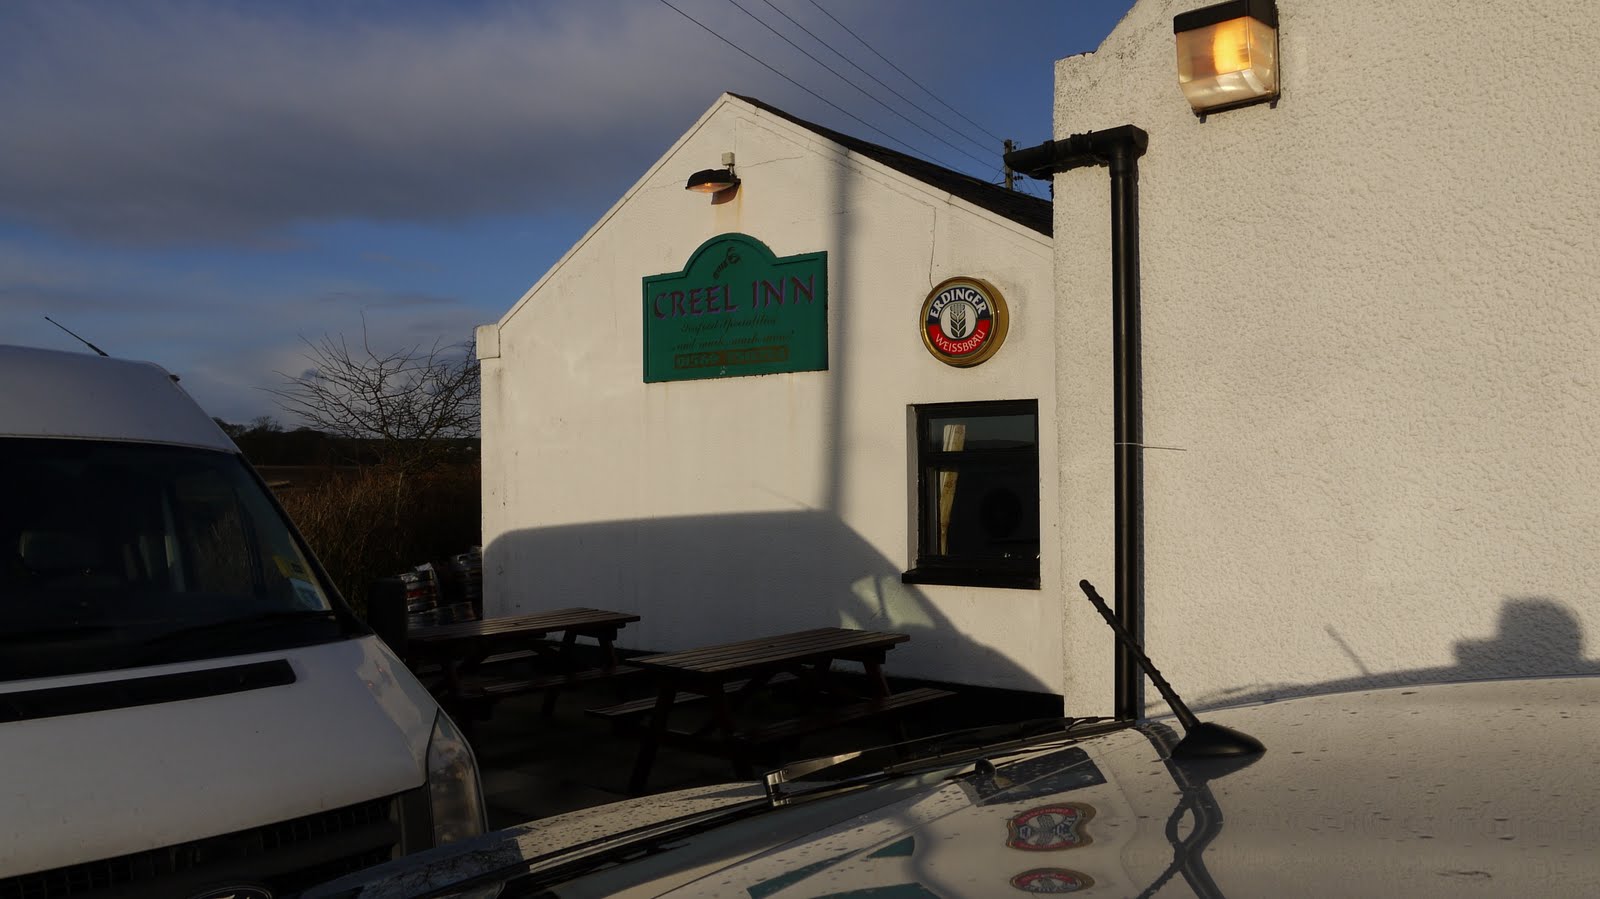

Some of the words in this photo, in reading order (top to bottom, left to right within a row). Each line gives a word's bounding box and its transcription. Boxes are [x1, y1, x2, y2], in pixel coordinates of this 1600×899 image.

[653, 284, 740, 320] CREEL
[752, 273, 817, 310] INN
[929, 288, 988, 318] ERDINGER
